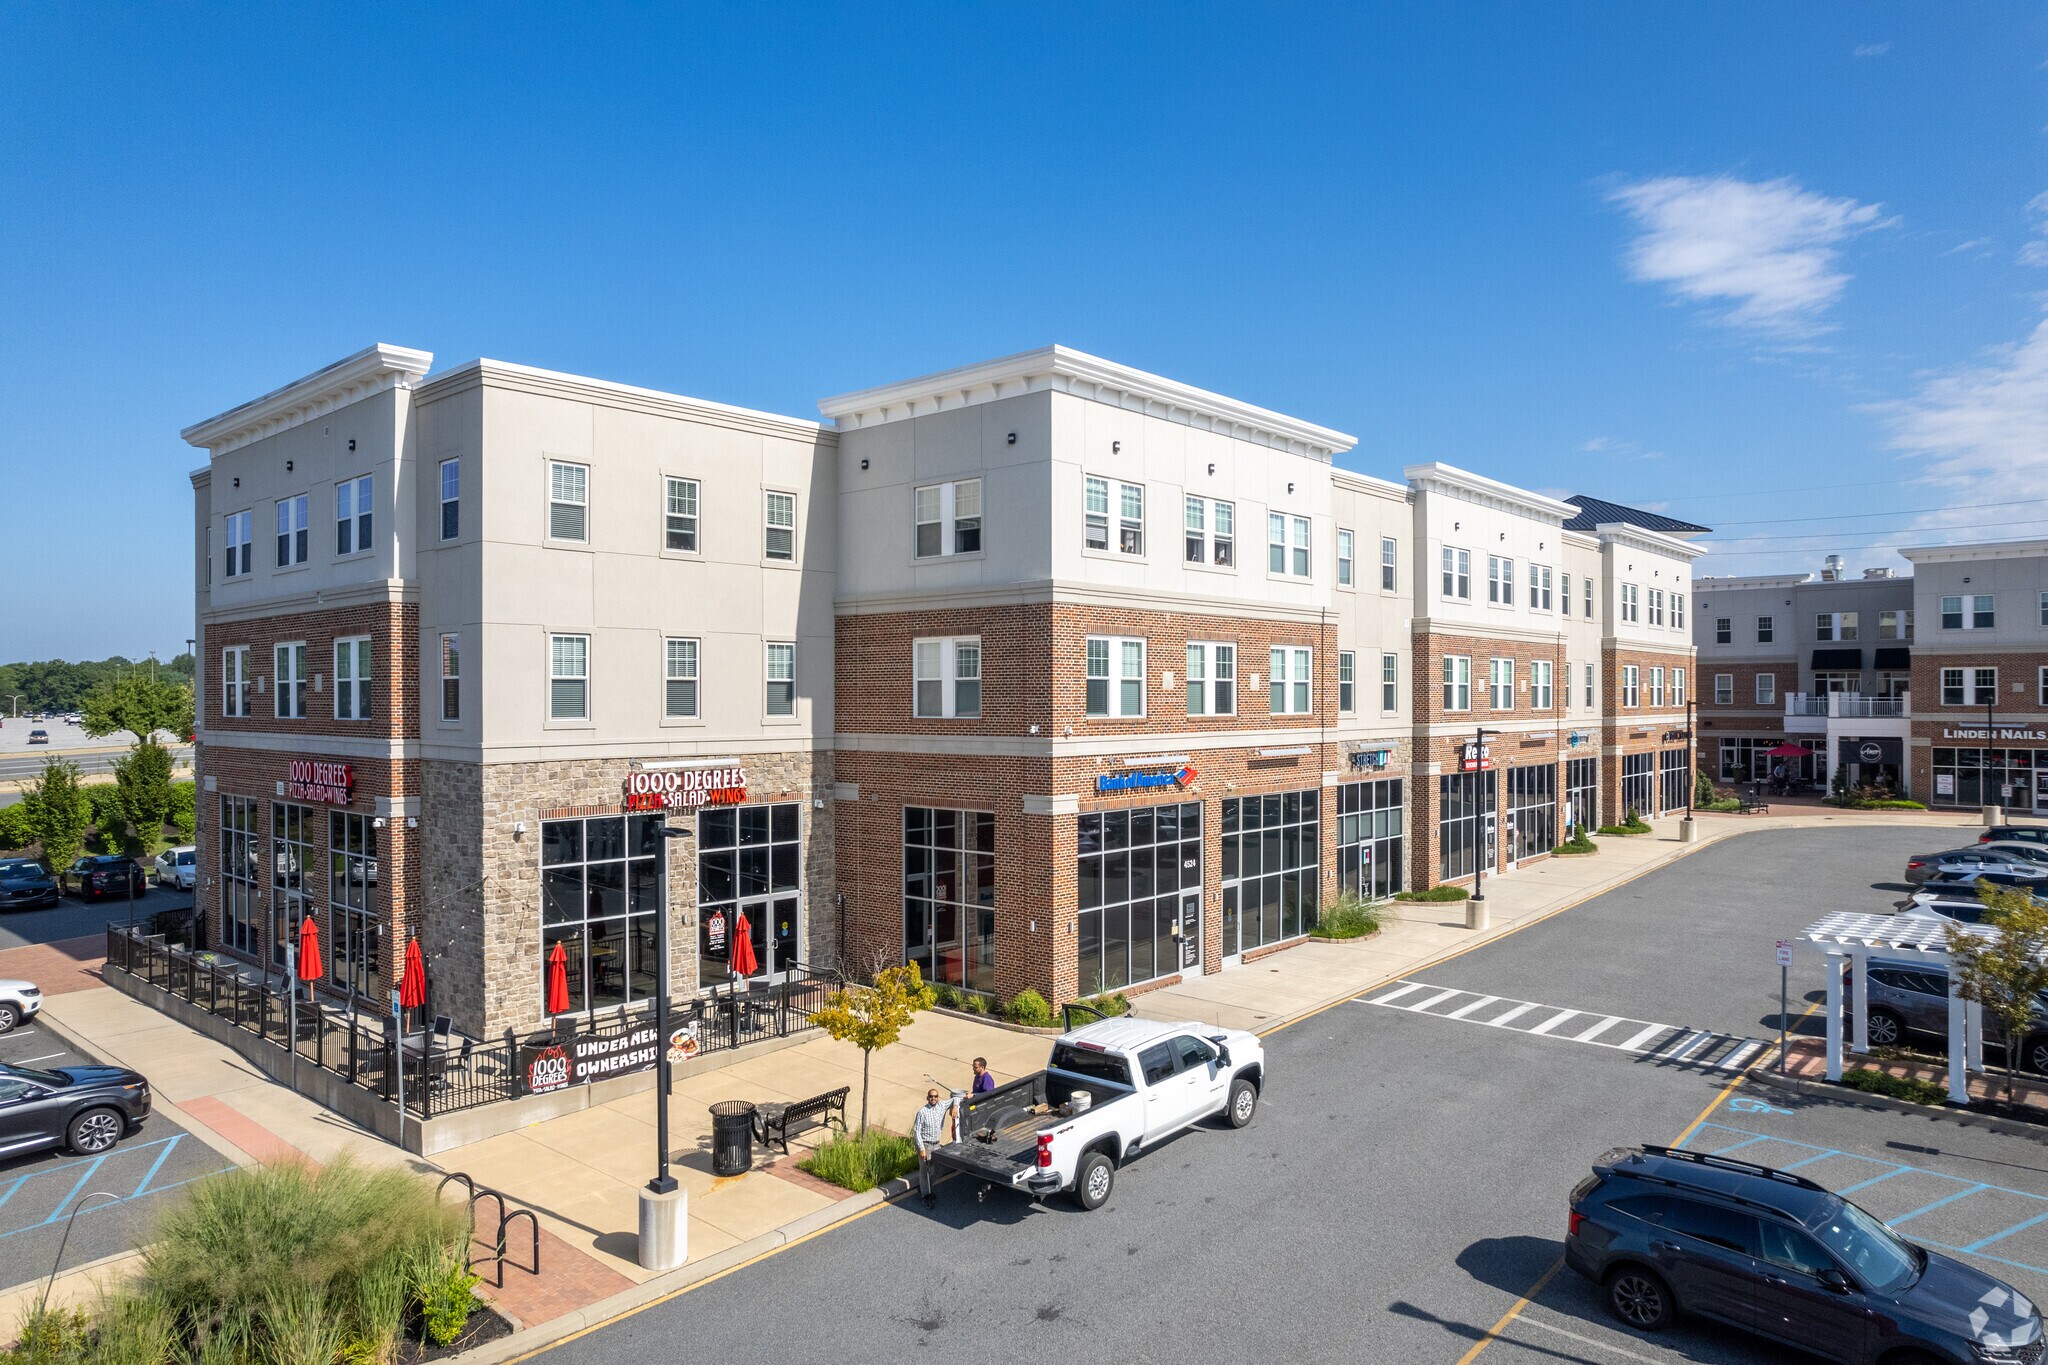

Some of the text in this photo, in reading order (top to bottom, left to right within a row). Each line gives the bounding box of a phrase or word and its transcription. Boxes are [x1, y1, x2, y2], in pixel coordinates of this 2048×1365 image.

[1943, 729, 2047, 740] LINDEN NAILS
[290, 760, 347, 787] 1000 DEGREES
[629, 768, 747, 794] 1000 DEGREES
[1100, 772, 1125, 791] Bank
[1136, 770, 1175, 787] America
[667, 790, 706, 808] SALAD
[709, 787, 747, 804] WINGS
[1183, 859, 1197, 869] 4524
[576, 1035, 629, 1058] UNDER
[533, 1057, 567, 1075] 1000
[576, 1047, 659, 1077] OWNERSHI
[532, 1070, 568, 1087] DEGREES
